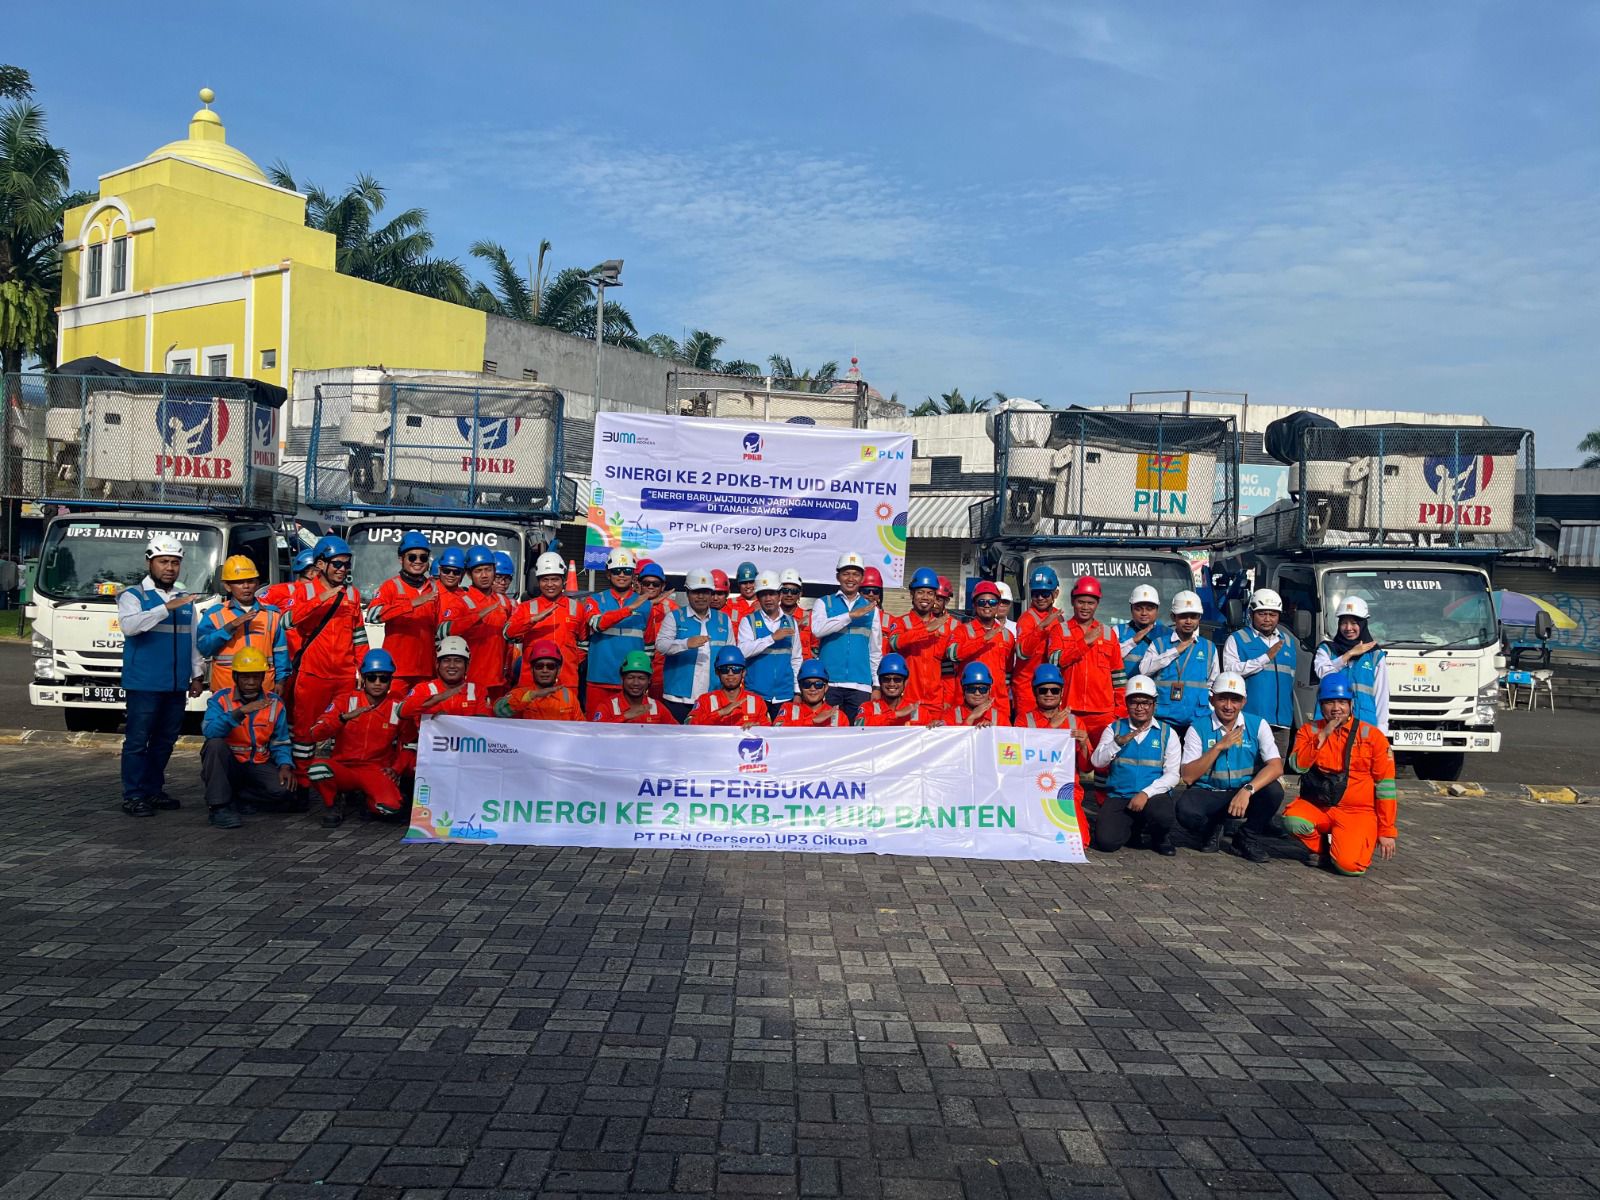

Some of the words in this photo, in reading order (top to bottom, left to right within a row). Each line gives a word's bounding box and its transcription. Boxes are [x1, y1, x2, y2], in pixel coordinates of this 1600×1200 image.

[254, 450, 276, 466] PDKB
[878, 450, 905, 460] PLN
[154, 454, 233, 479] PDKB
[461, 456, 516, 474] PDKB
[604, 465, 672, 482] SINERGI
[676, 470, 697, 484] KE
[701, 472, 712, 485] 2
[716, 472, 793, 490] PDKB-TM
[797, 477, 826, 492] UID
[830, 479, 897, 496] BANTEN
[686, 492, 712, 503] BARU
[713, 494, 765, 505] WUJUDKAN
[767, 498, 814, 508] JARINGAN
[815, 500, 853, 511] HANDAL
[707, 503, 717, 512] DI
[719, 504, 750, 513] TANAH
[751, 506, 793, 516] JAWARA"
[1133, 490, 1189, 515] PLN
[1418, 502, 1492, 526] PDKB
[66, 527, 92, 538] UP3
[94, 528, 145, 539] BANTEN
[368, 528, 402, 542] UP3
[407, 529, 498, 546] ERPONG
[669, 521, 684, 531] PT
[686, 522, 708, 533] PLN
[710, 523, 762, 537] (Persero)
[764, 527, 787, 537] UP3
[789, 528, 827, 541] Cikupa
[731, 543, 756, 552] 19-23
[757, 545, 771, 553] Mei
[773, 545, 795, 554] 2025
[1071, 562, 1091, 577] UP3
[1091, 562, 1122, 577] TELUK
[1124, 563, 1153, 577] NAGA
[1383, 579, 1404, 589] UP3
[1406, 580, 1442, 590] CIKUPA
[92, 639, 124, 648] ISUZ
[84, 687, 90, 697] B
[94, 688, 114, 698] 9102
[1398, 684, 1441, 692] ISUZU
[432, 736, 488, 753] BUMN
[1394, 731, 1400, 741] B
[1403, 732, 1423, 741] 9079
[1426, 732, 1442, 742] CIA
[1025, 749, 1062, 763] PLN
[637, 778, 704, 798] APEL
[710, 780, 866, 800] PEMBUKAAN
[481, 799, 607, 824] SINERGI
[615, 801, 654, 825] KE
[662, 802, 680, 825] 2
[689, 802, 827, 827] PDKB-TM
[835, 804, 886, 828] UID
[895, 805, 1016, 828] BANTEN
[633, 832, 656, 841] PT
[659, 832, 692, 842] PLN
[696, 831, 771, 844] (Persero)
[775, 834, 808, 845] UP3
[812, 834, 868, 847] Cikupa
